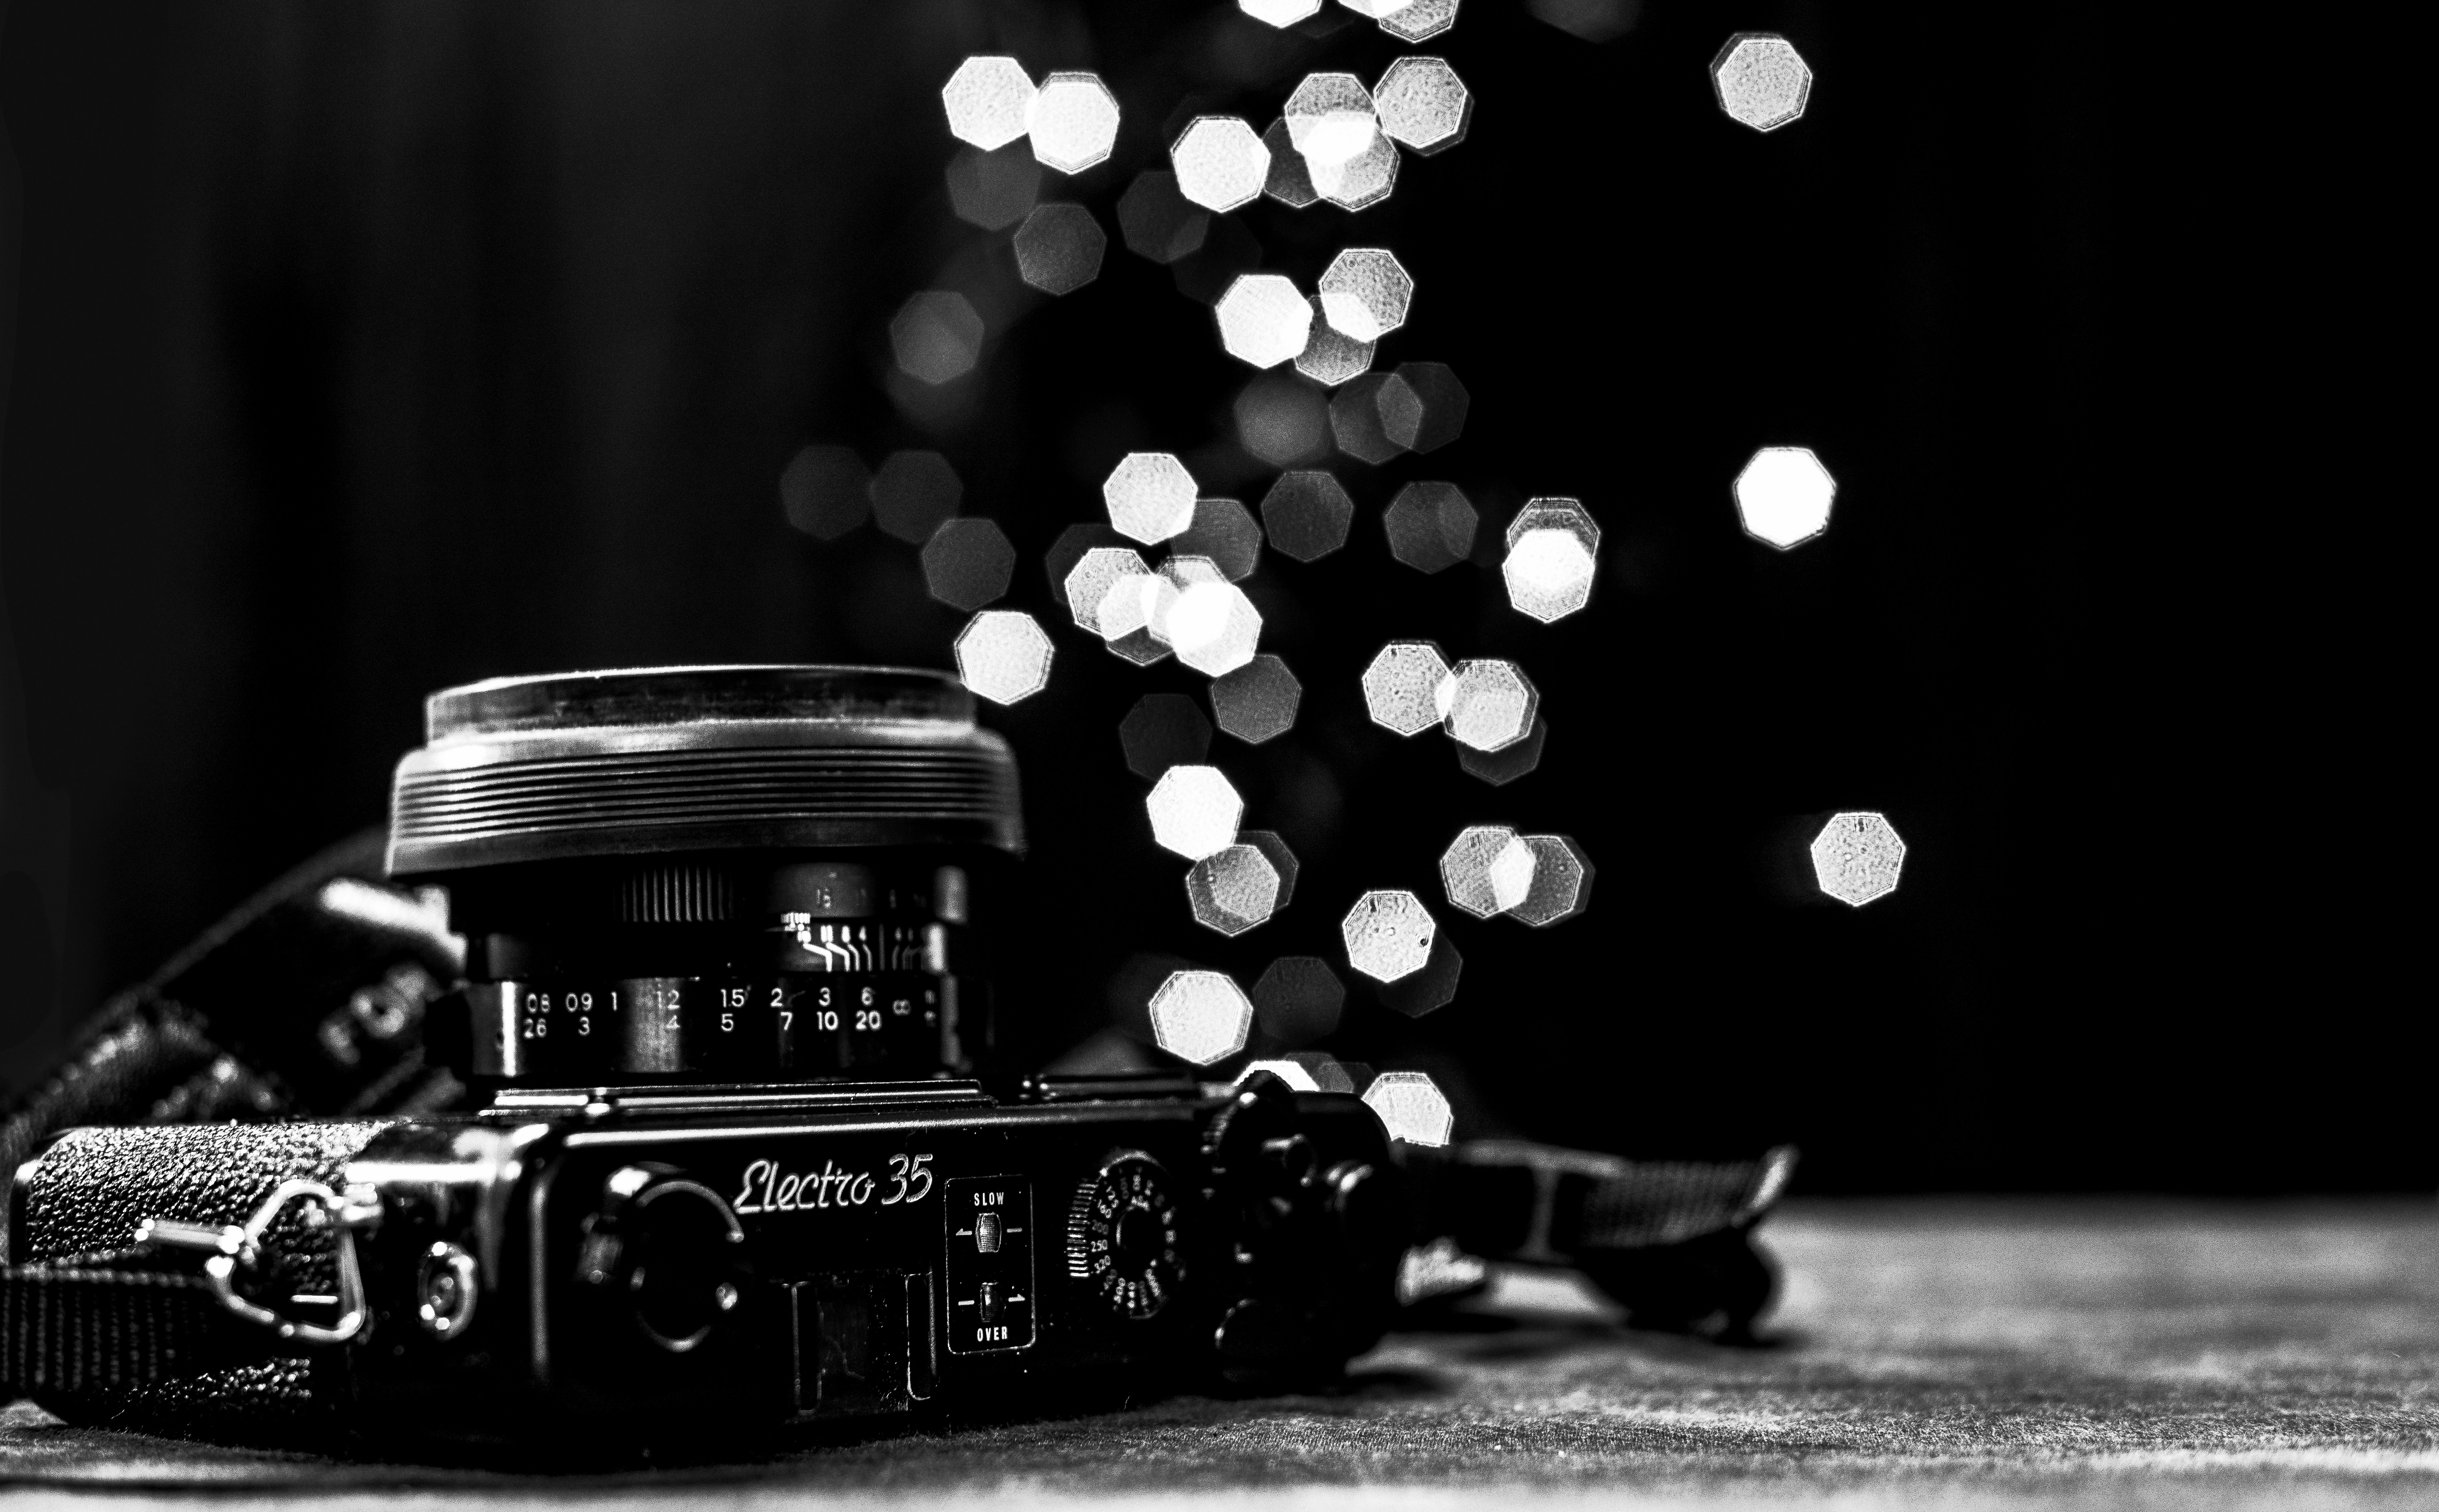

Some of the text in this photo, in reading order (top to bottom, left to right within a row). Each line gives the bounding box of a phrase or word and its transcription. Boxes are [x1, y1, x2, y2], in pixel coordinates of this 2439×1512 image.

[611, 991, 617, 1011] 1
[770, 987, 783, 1008] 2
[818, 986, 831, 1007] 3
[861, 986, 873, 1006] 6
[578, 1016, 591, 1036] 3
[720, 1012, 735, 1032] 5
[779, 1011, 794, 1031] 7
[816, 1010, 839, 1032] 10
[855, 1010, 882, 1031] 20
[733, 1153, 934, 1214] Electro 35
[974, 1192, 1004, 1206] SLOW
[1090, 1239, 1109, 1253] 250
[977, 1326, 1009, 1342] OVER
